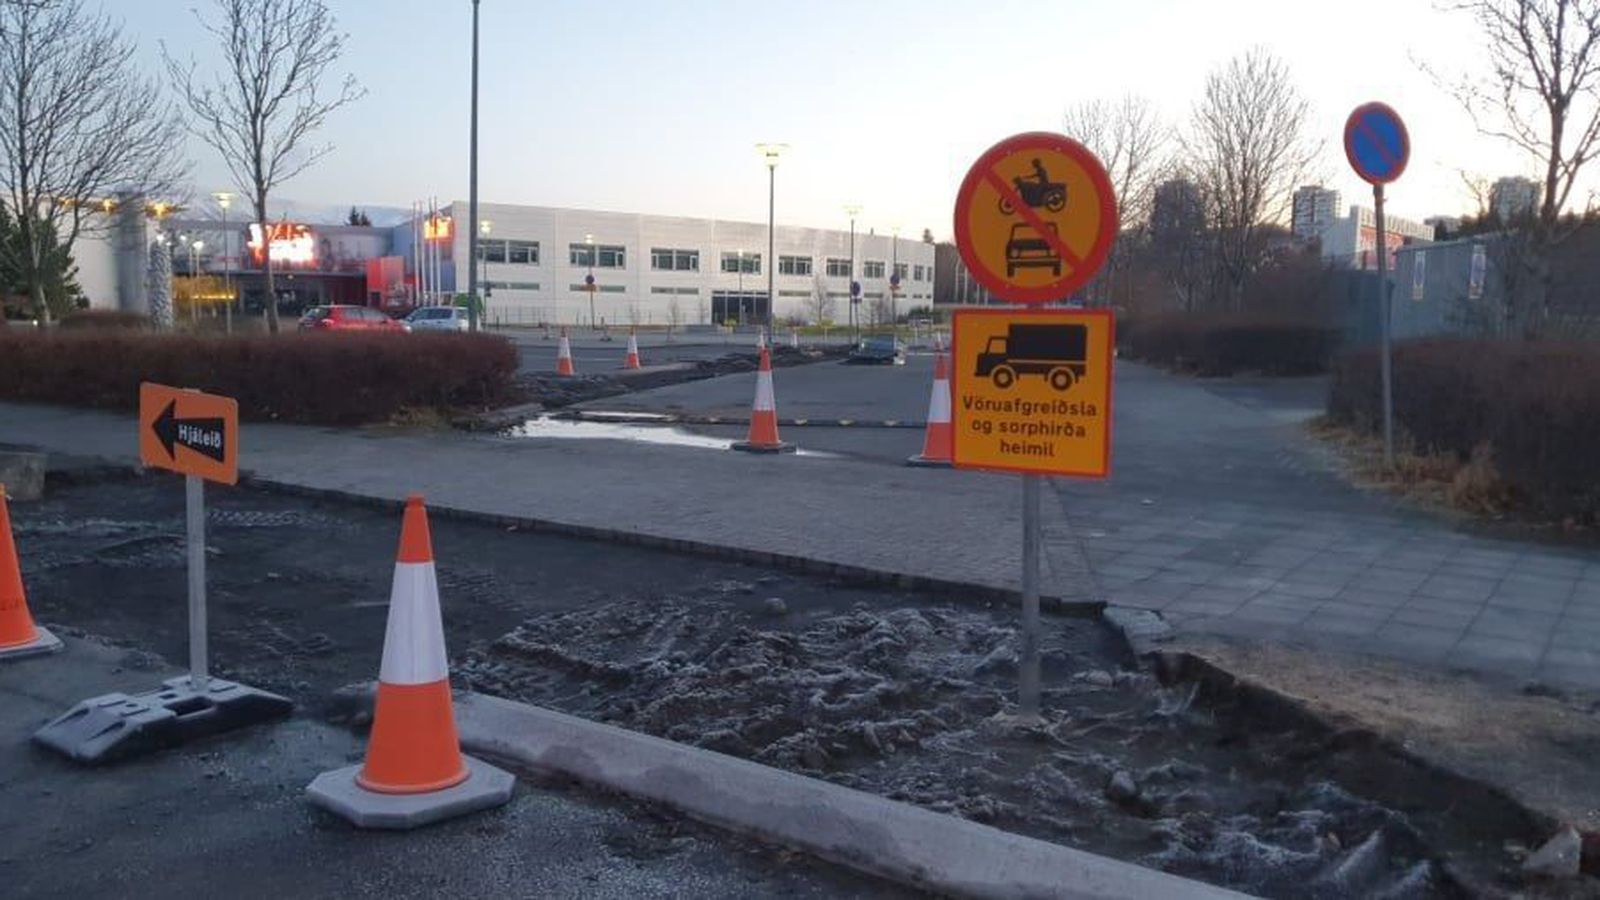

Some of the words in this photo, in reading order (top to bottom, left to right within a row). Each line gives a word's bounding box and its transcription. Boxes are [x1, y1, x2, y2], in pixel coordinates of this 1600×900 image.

[963, 396, 1096, 416] Vöruafgreiðsla
[178, 424, 221, 448] Hjáleið
[972, 420, 992, 434] og
[999, 421, 1086, 437] sorphirða
[1000, 440, 1055, 457] heimil
